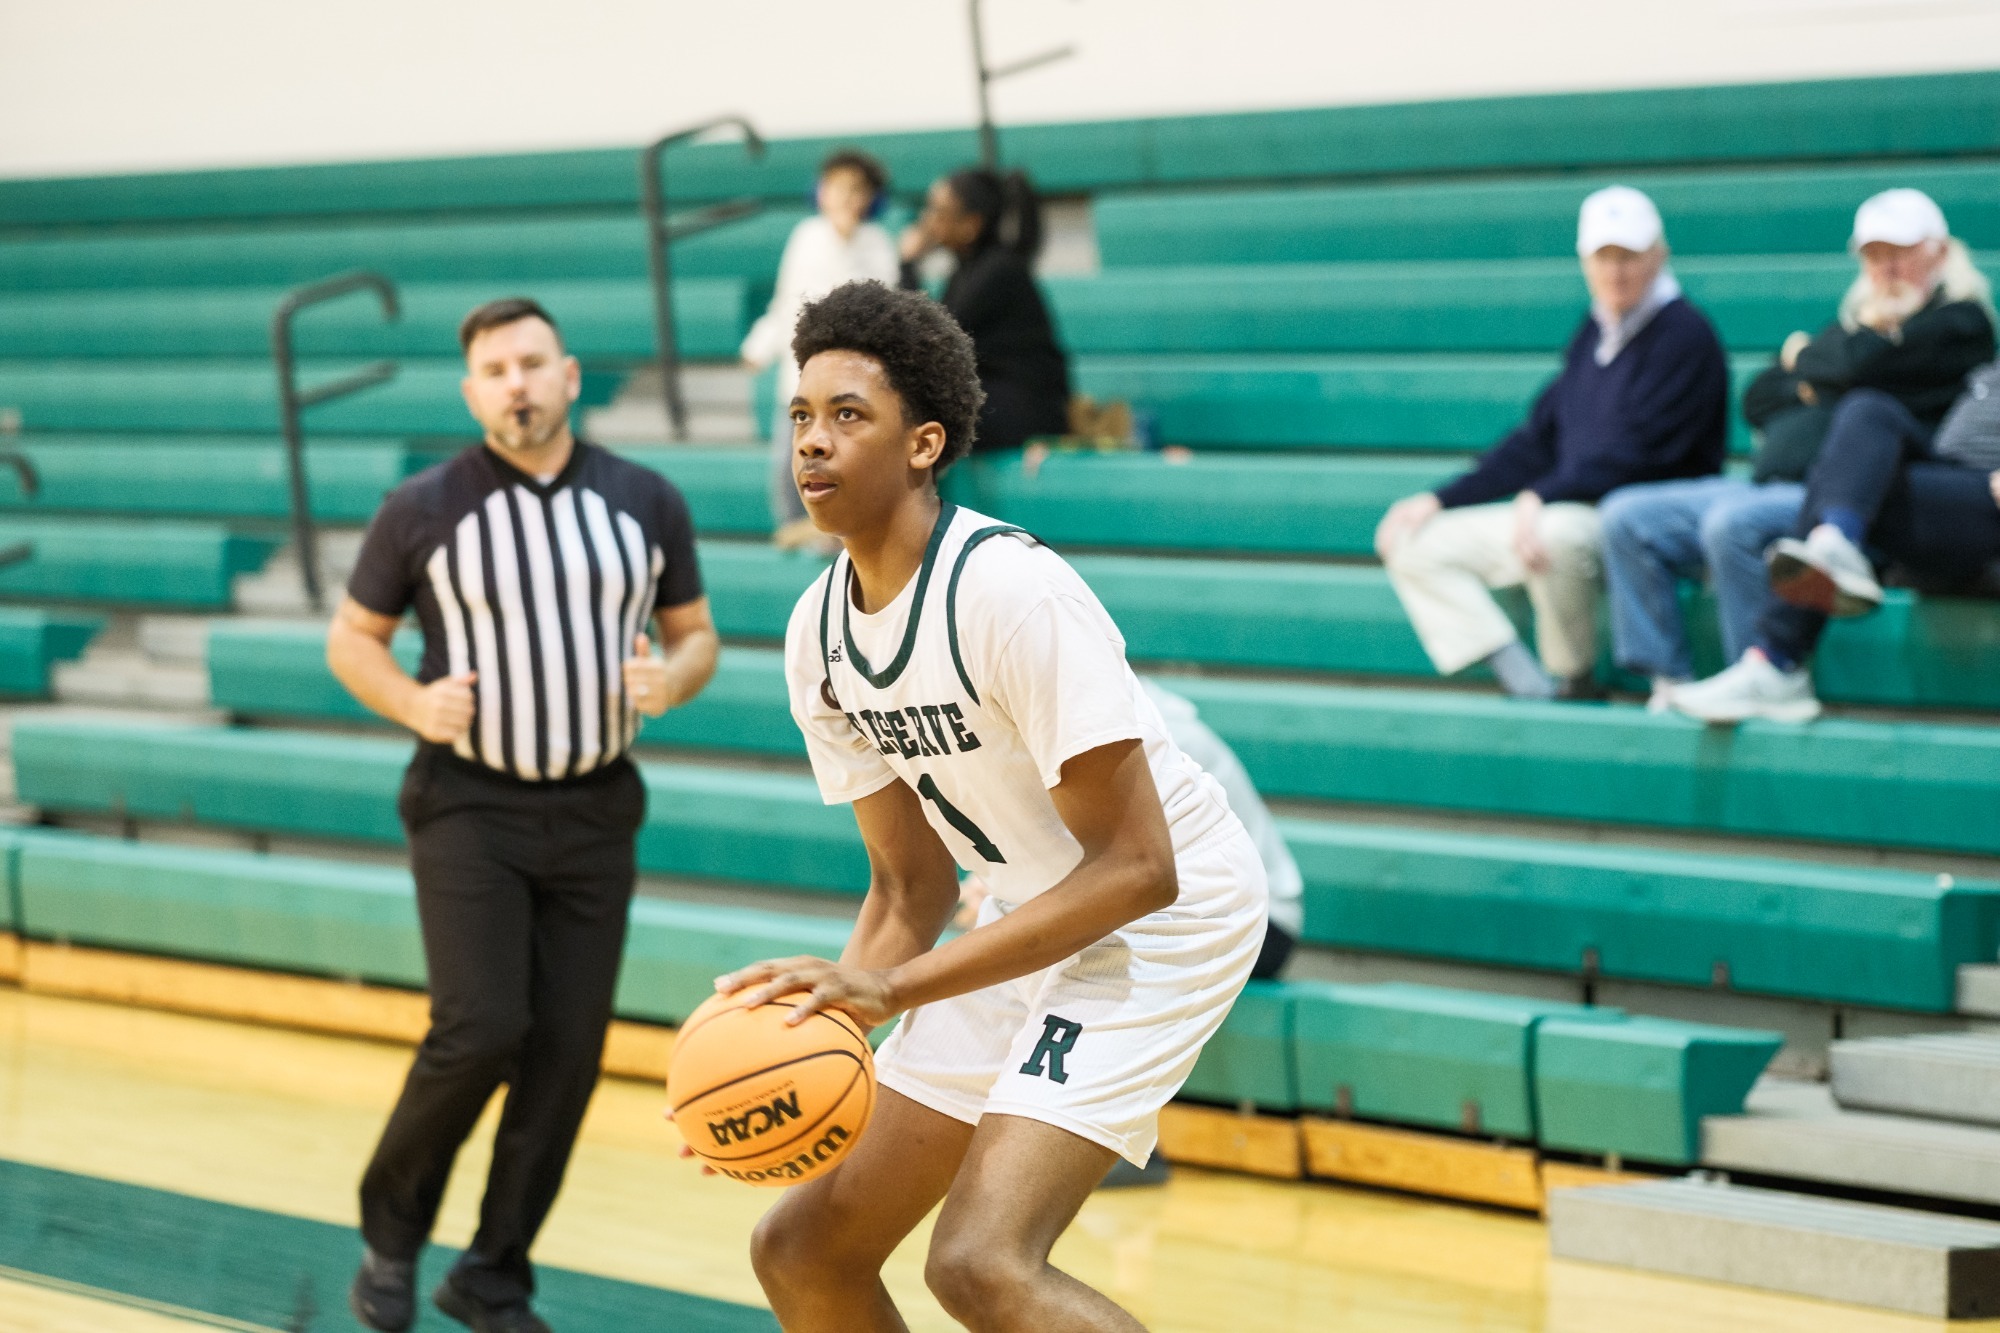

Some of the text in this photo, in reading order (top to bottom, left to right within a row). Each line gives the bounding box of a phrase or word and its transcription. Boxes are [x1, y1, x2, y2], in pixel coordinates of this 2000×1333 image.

[917, 773, 1008, 864] 1
[1018, 1014, 1084, 1085] R
[706, 1090, 803, 1146] NCAA
[718, 1124, 853, 1182] Wilson
